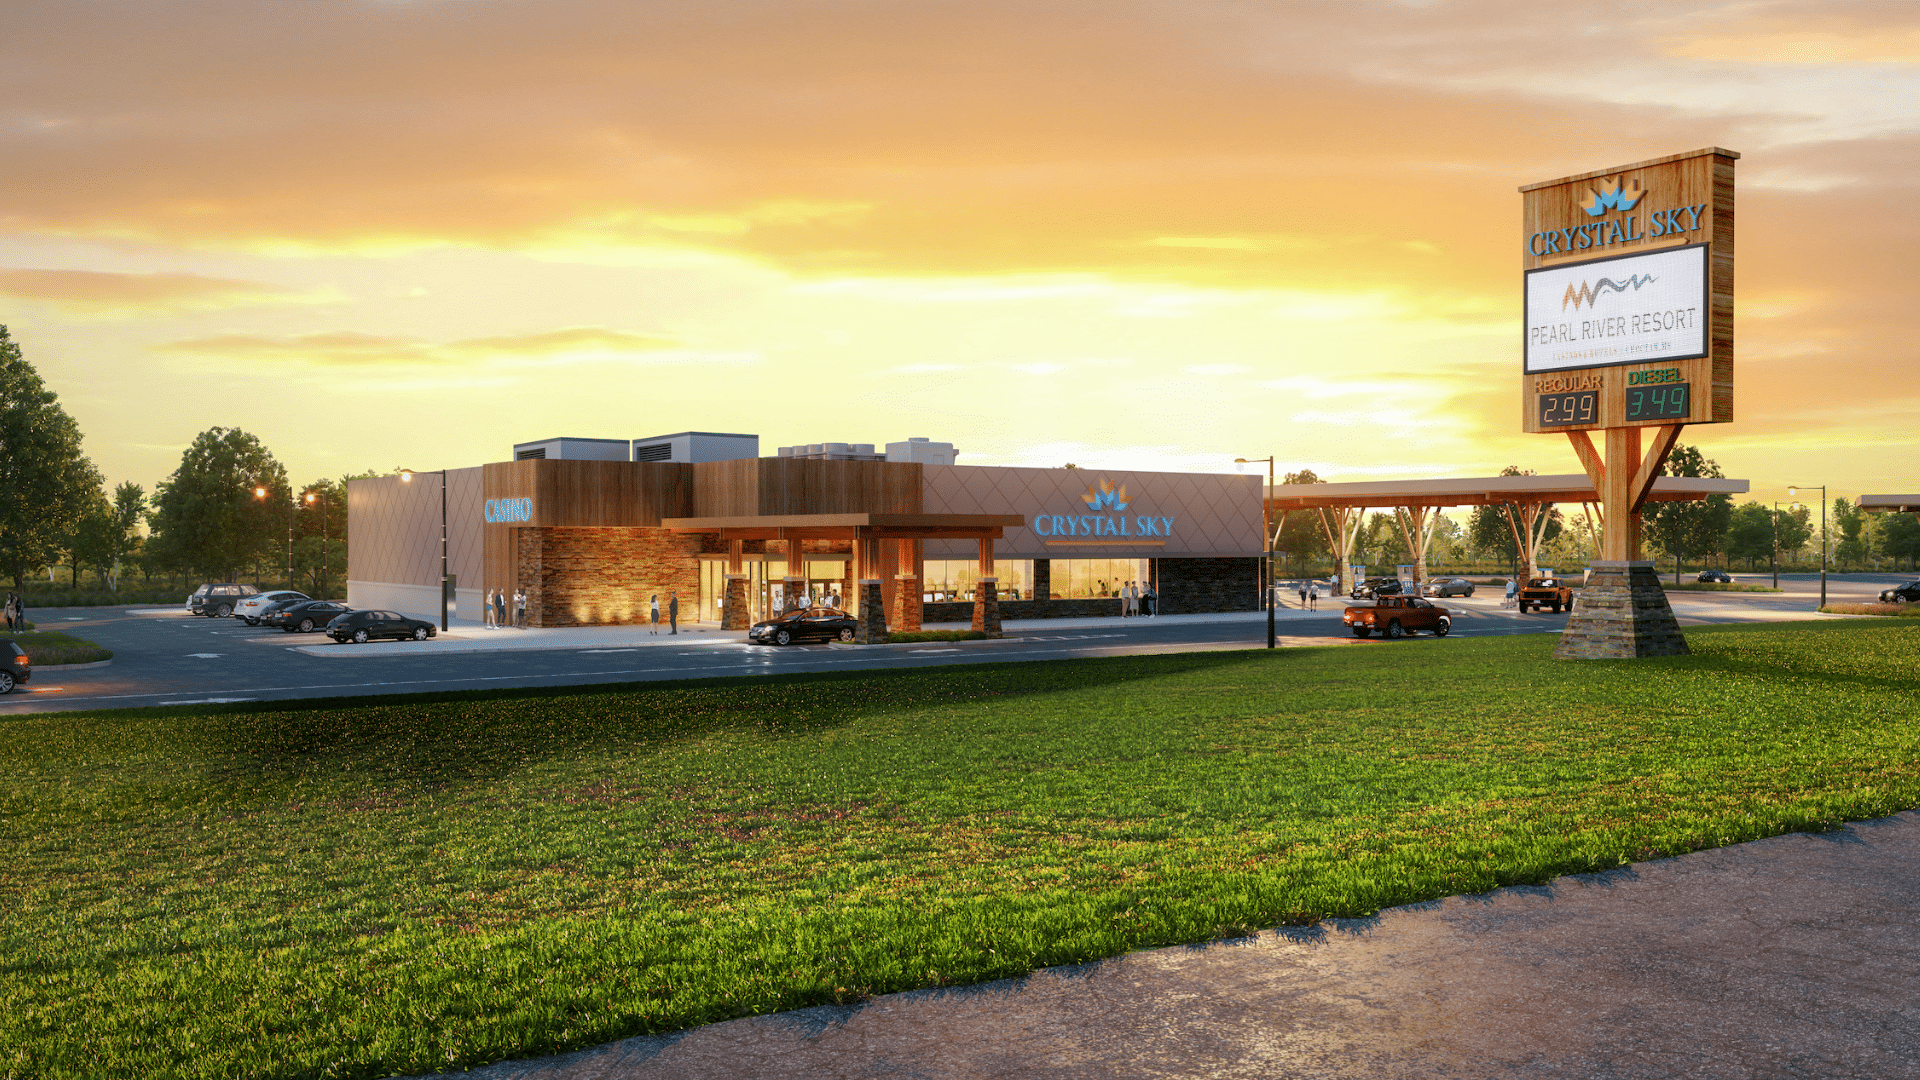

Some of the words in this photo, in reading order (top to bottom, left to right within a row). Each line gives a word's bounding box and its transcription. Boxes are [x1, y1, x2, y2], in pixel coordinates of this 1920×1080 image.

[1528, 216, 1643, 256] CRYSTAL
[1650, 203, 1706, 237] SKY
[1531, 323, 1576, 345] PEARL
[1582, 316, 1626, 340] RIVER
[1631, 308, 1696, 334] RESORT
[1535, 375, 1603, 393] REGULAR
[1628, 368, 1684, 385] DIESEL
[1543, 395, 1593, 422] 2.99
[1630, 387, 1685, 416] 3.49
[485, 498, 532, 522] CASINO
[1034, 515, 1131, 536] CRYSTAL
[1136, 516, 1175, 536] SKY
